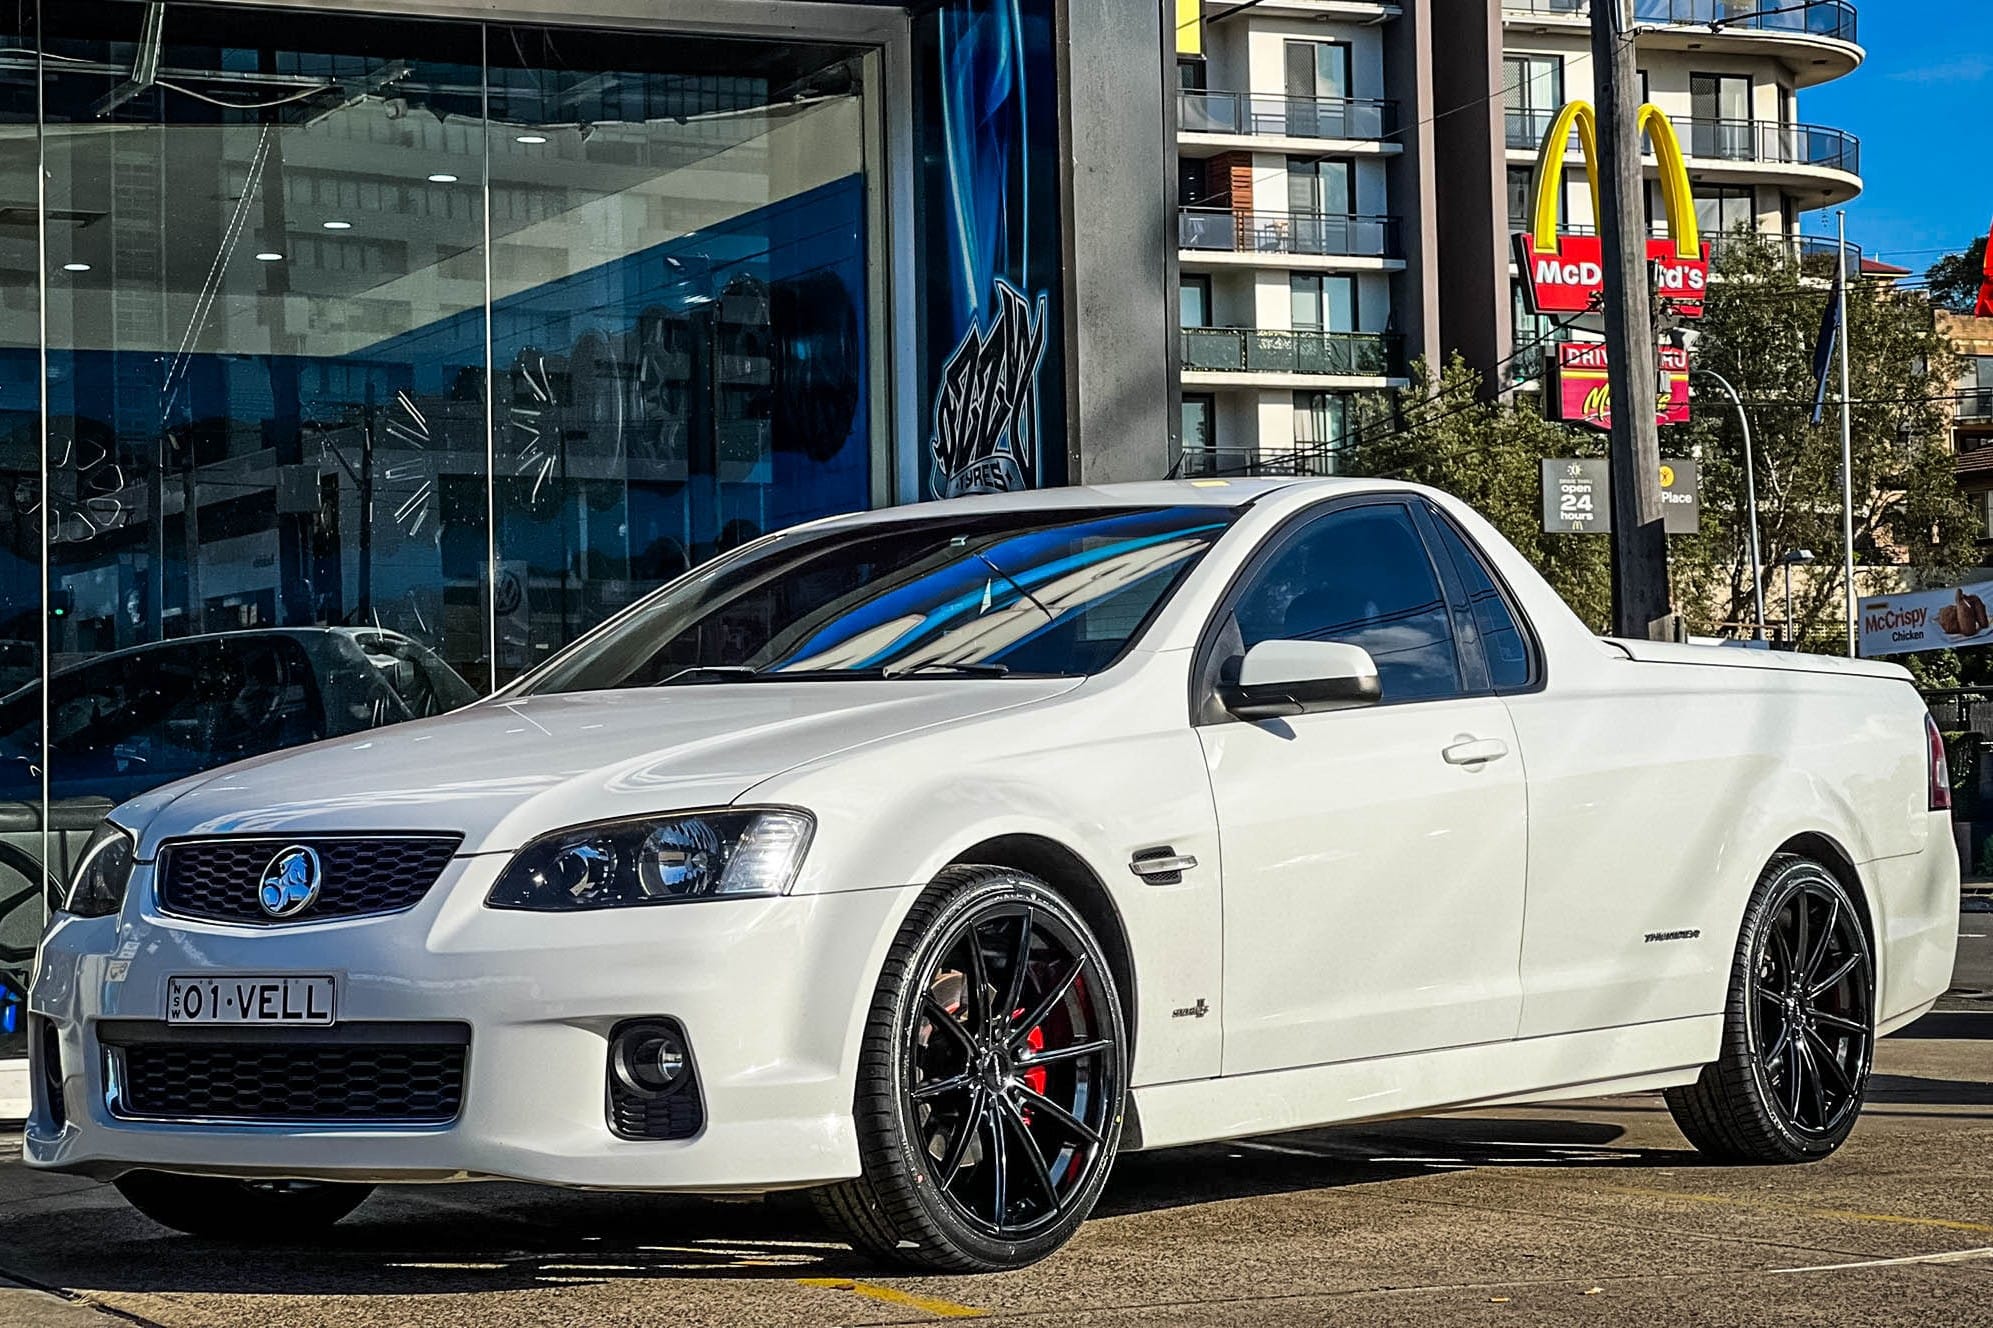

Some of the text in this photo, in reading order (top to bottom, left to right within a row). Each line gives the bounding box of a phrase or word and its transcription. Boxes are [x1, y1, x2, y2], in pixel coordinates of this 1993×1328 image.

[1568, 348, 1609, 365] DRIV
[958, 462, 1007, 488] TYRES
[1560, 484, 1592, 494] open
[1560, 494, 1594, 511] 24
[1560, 510, 1594, 521] hours
[1865, 606, 1928, 635] McCrispy
[1892, 630, 1925, 642] Chicken
